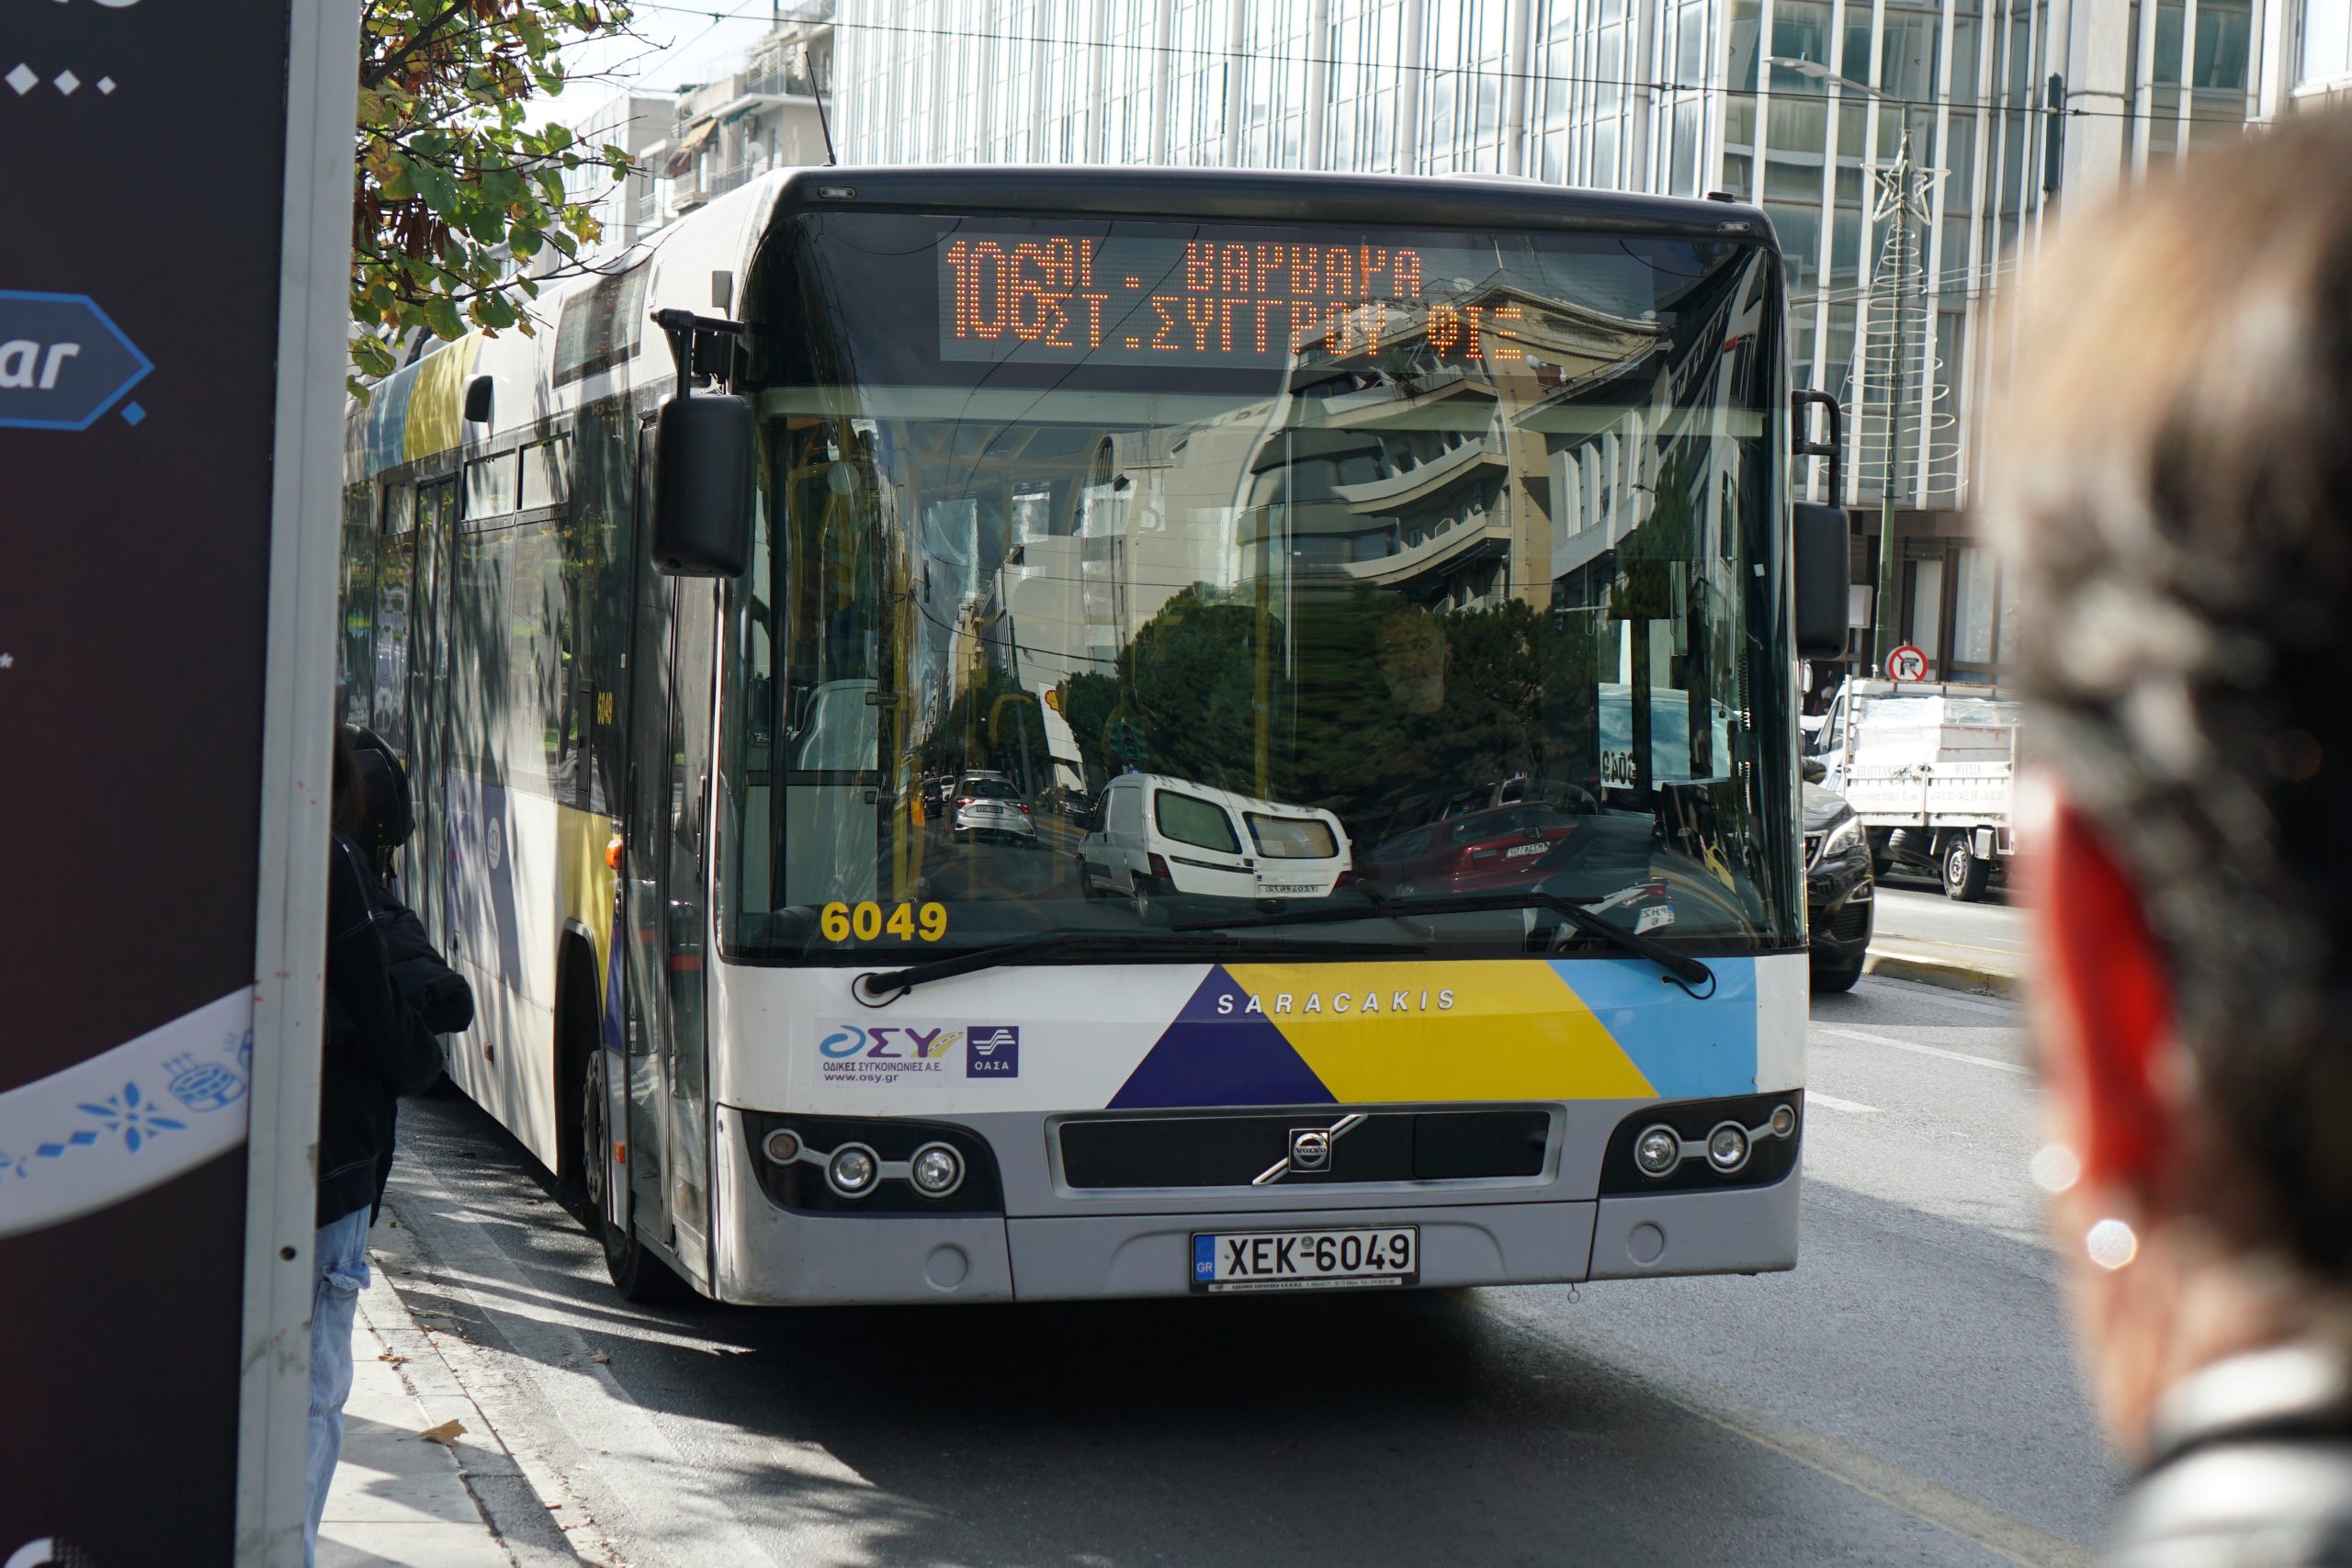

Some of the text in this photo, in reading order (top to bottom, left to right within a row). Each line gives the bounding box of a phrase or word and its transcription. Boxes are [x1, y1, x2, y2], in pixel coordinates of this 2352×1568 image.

[947, 240, 1046, 340] 106
[597, 691, 613, 726] 6049
[820, 900, 947, 942] 6049
[1216, 988, 1455, 1015] SARACAKIS
[822, 1062, 943, 1072] ΟΔΙΚΕΣ ΣΥΓΚΟΙΝΩΝΙΕΣ Α.Ε.
[824, 1072, 899, 1083] www.osy.gr
[974, 1060, 1010, 1071] ΟΑΣΑ
[1196, 1261, 1213, 1274] GR
[1227, 1234, 1410, 1276] XEK-6049
